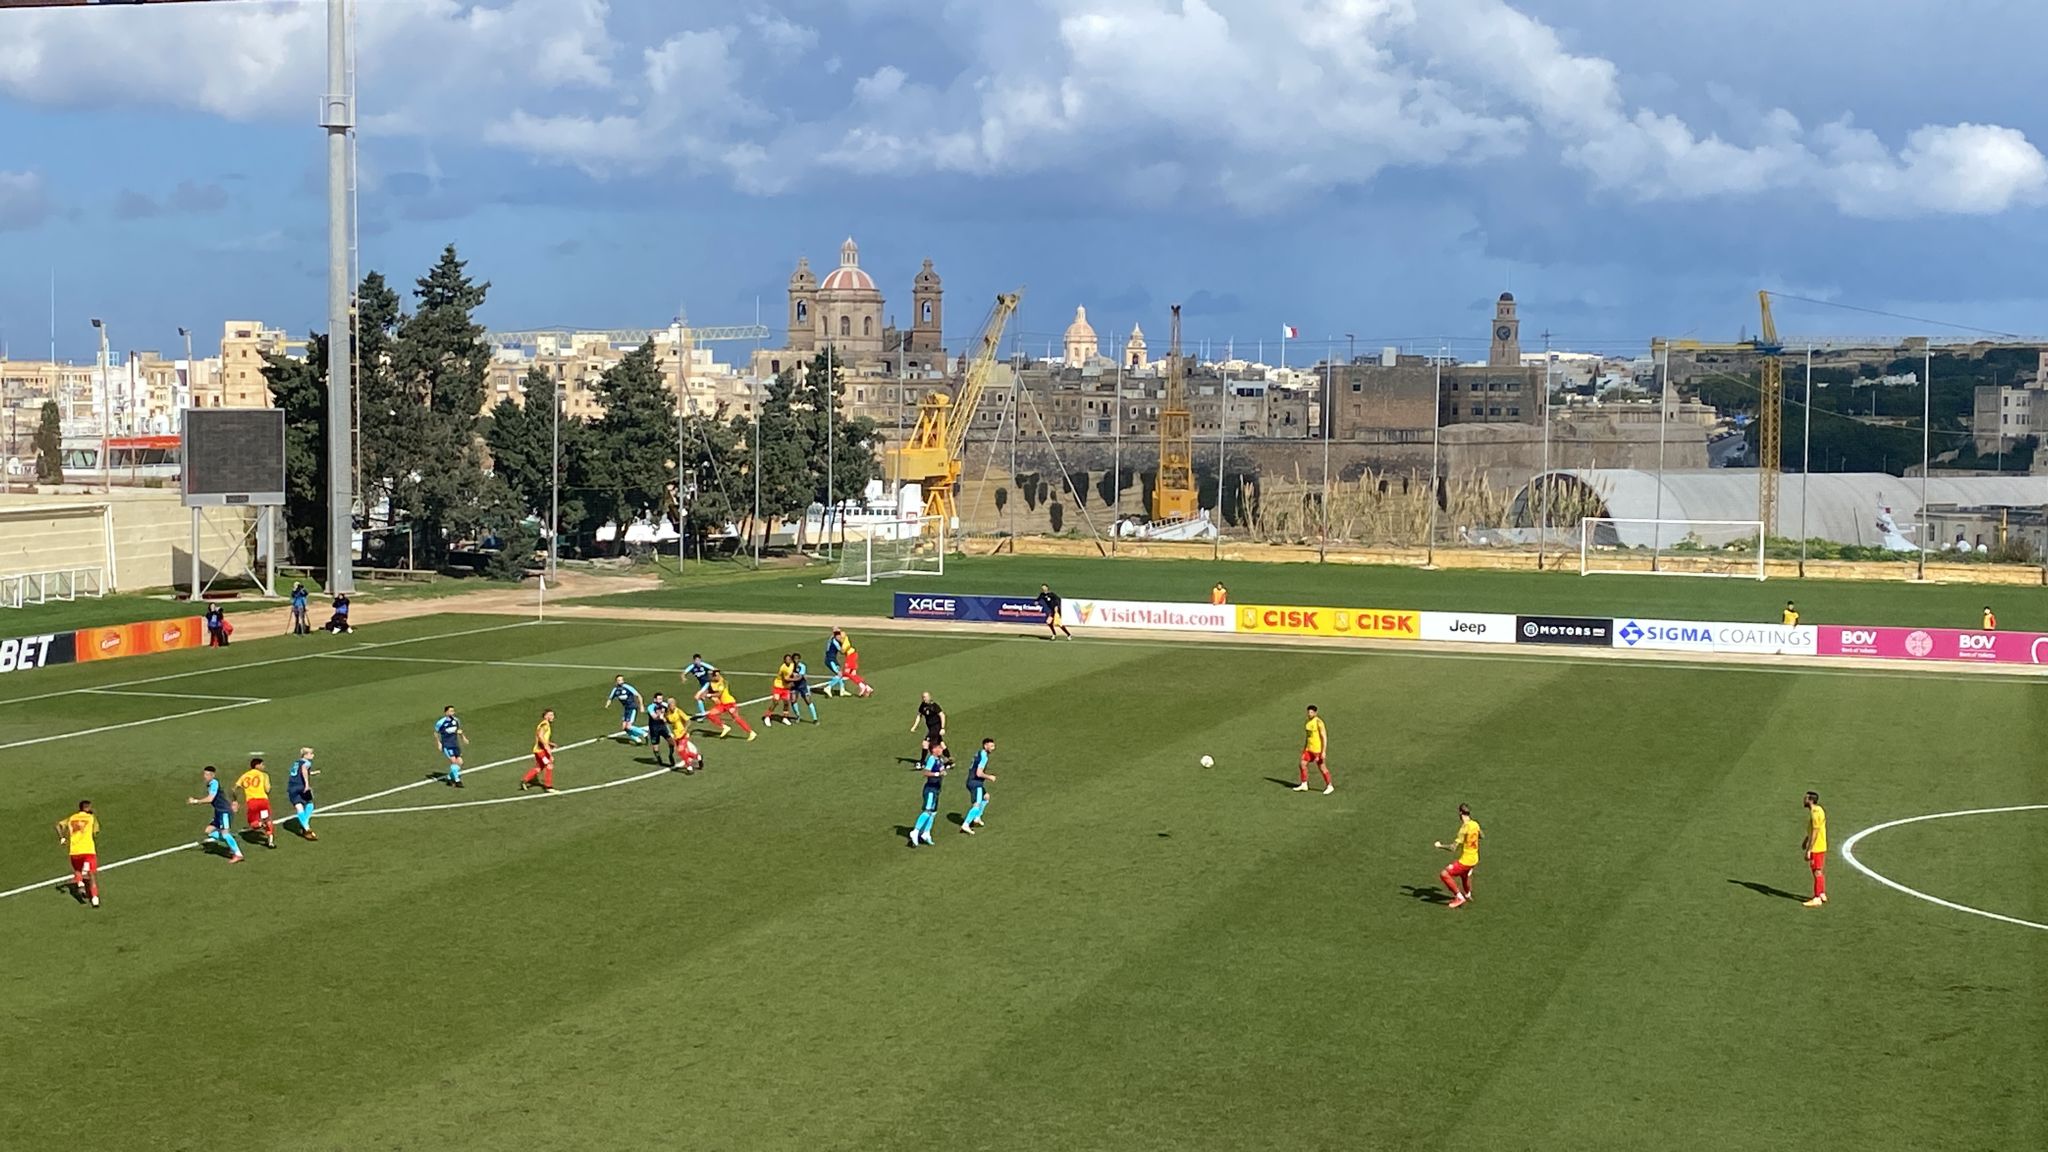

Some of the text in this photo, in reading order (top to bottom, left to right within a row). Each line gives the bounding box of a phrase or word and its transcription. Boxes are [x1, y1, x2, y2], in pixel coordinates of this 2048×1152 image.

[908, 597, 956, 611] XACE
[1100, 607, 1225, 627] VisitMalta.com
[1263, 610, 1319, 630] CISK
[1357, 613, 1413, 633] CISK
[1449, 619, 1487, 635] Jeep
[1540, 625, 1591, 636] MOTORS
[1646, 626, 1811, 646] SIGMA COATINGS
[1841, 630, 1877, 645] BOV
[1959, 634, 1996, 649] BOV
[0, 634, 55, 673] BET
[242, 776, 260, 789] 30
